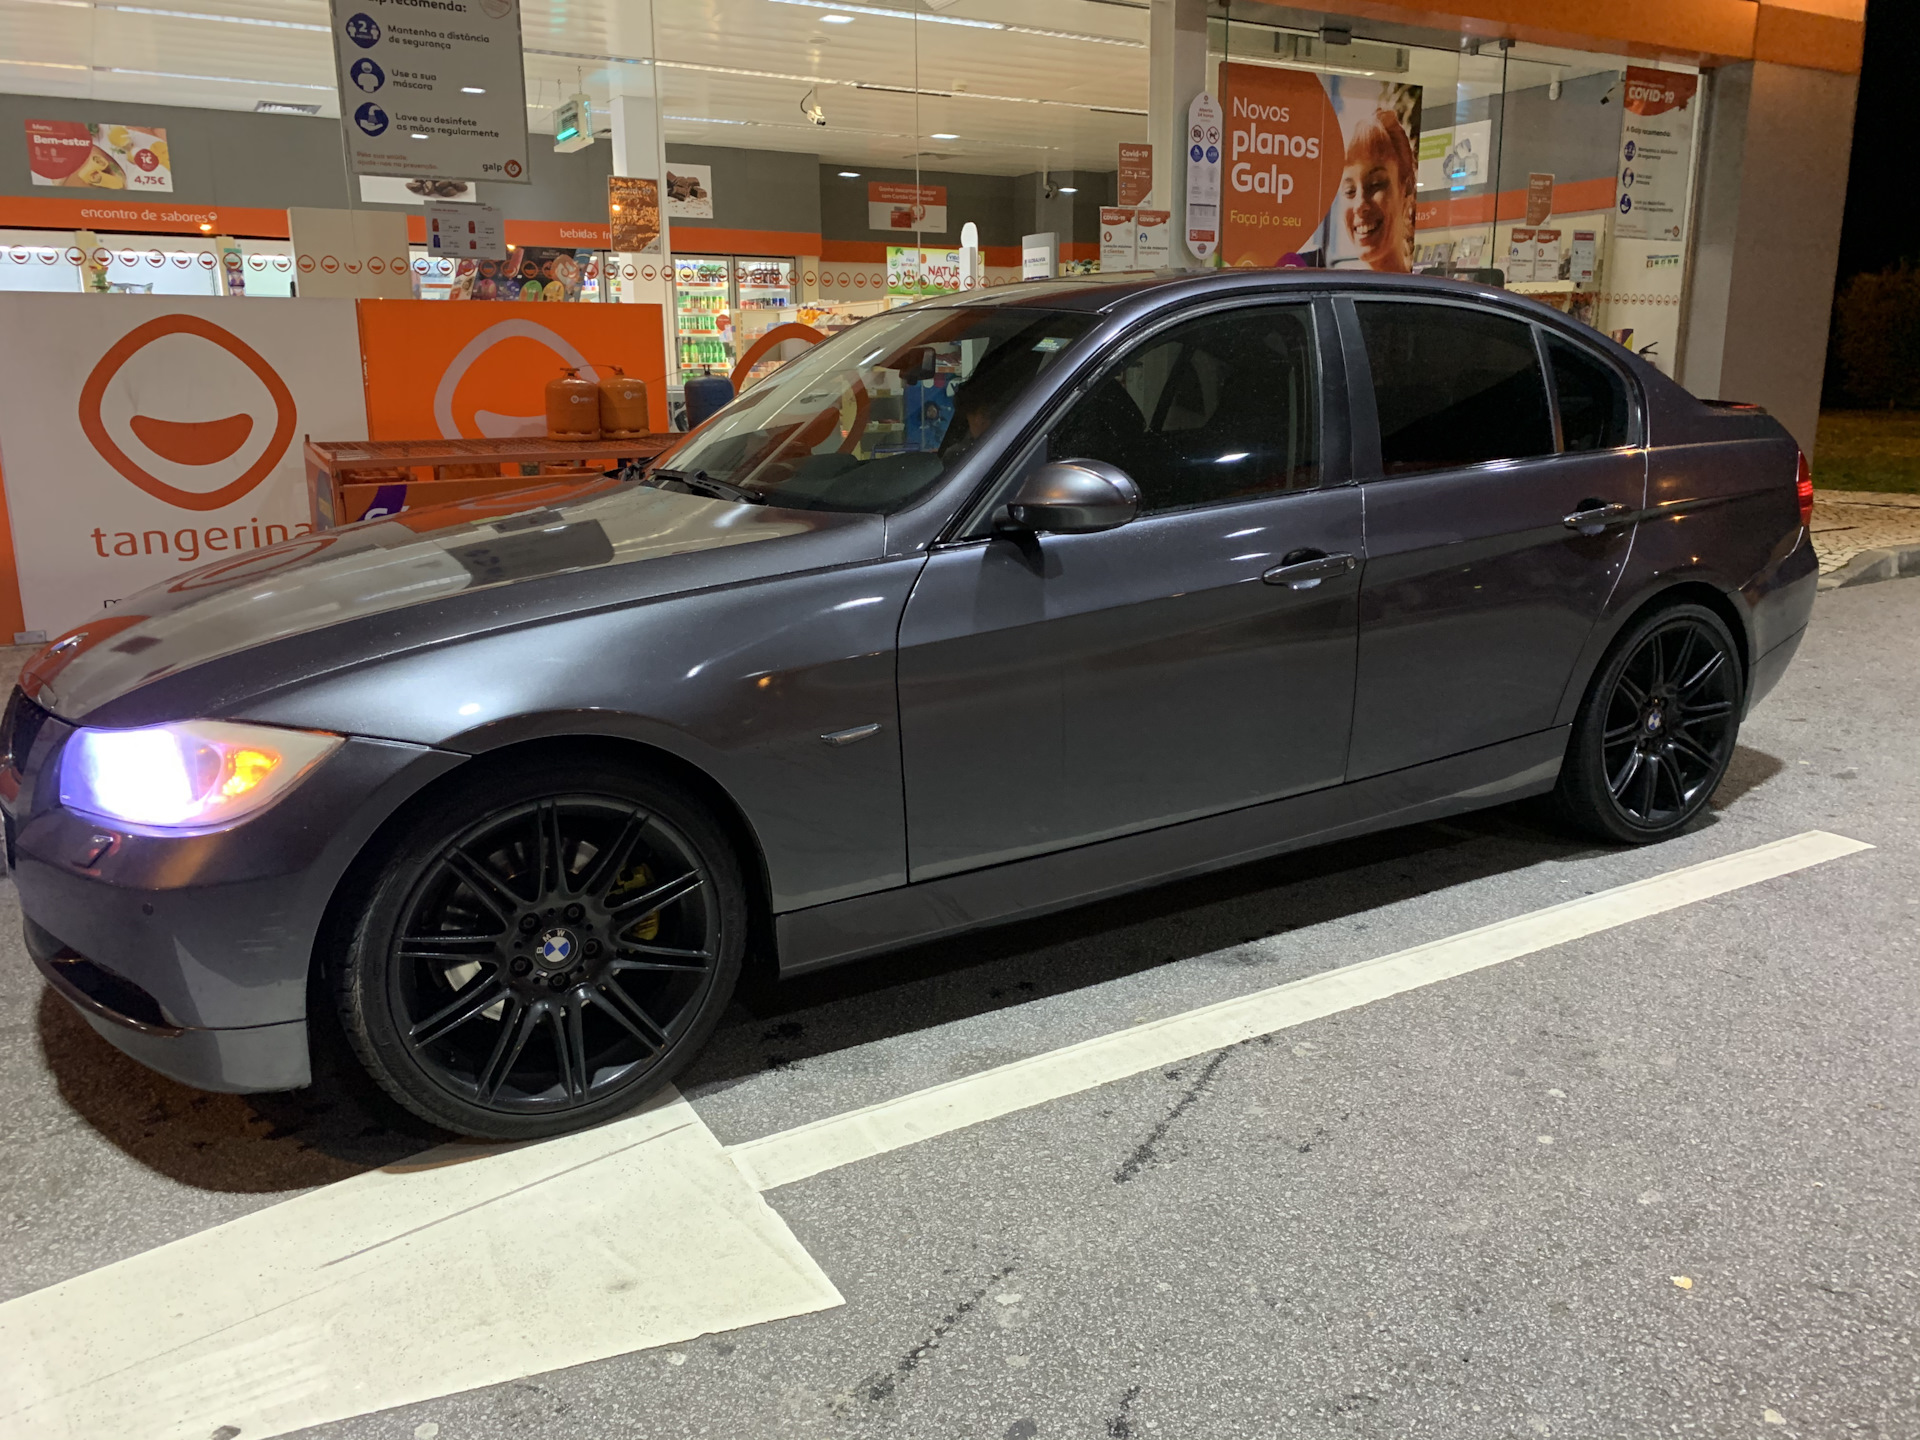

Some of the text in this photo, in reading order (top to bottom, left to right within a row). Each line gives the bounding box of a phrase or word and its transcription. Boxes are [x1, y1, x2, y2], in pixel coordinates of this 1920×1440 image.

[388, 25, 437, 38] Mantenha
[447, 32, 490, 43] distância
[388, 36, 451, 50] de segurança
[391, 69, 409, 78] Use
[393, 79, 433, 90] máscara
[1628, 86, 1675, 104] COVID-19
[1233, 96, 1290, 122] Novos
[395, 113, 419, 123] Lave
[434, 116, 477, 126] desinfete
[32, 123, 53, 131] Menu
[410, 123, 436, 133] mãos
[438, 127, 499, 138] regularmente
[33, 135, 91, 147] Bem-estar
[1232, 122, 1320, 161] planos
[1121, 149, 1148, 158] Covid-19
[482, 163, 502, 172] galp
[134, 175, 165, 185] 4,75€
[1231, 162, 1294, 204] Galp
[81, 208, 208, 223] encontro de sabores
[1230, 210, 1302, 229] Faça já o seu
[560, 228, 598, 239] bebidas
[90, 517, 313, 562] tangerina
[536, 929, 566, 954] BMW
